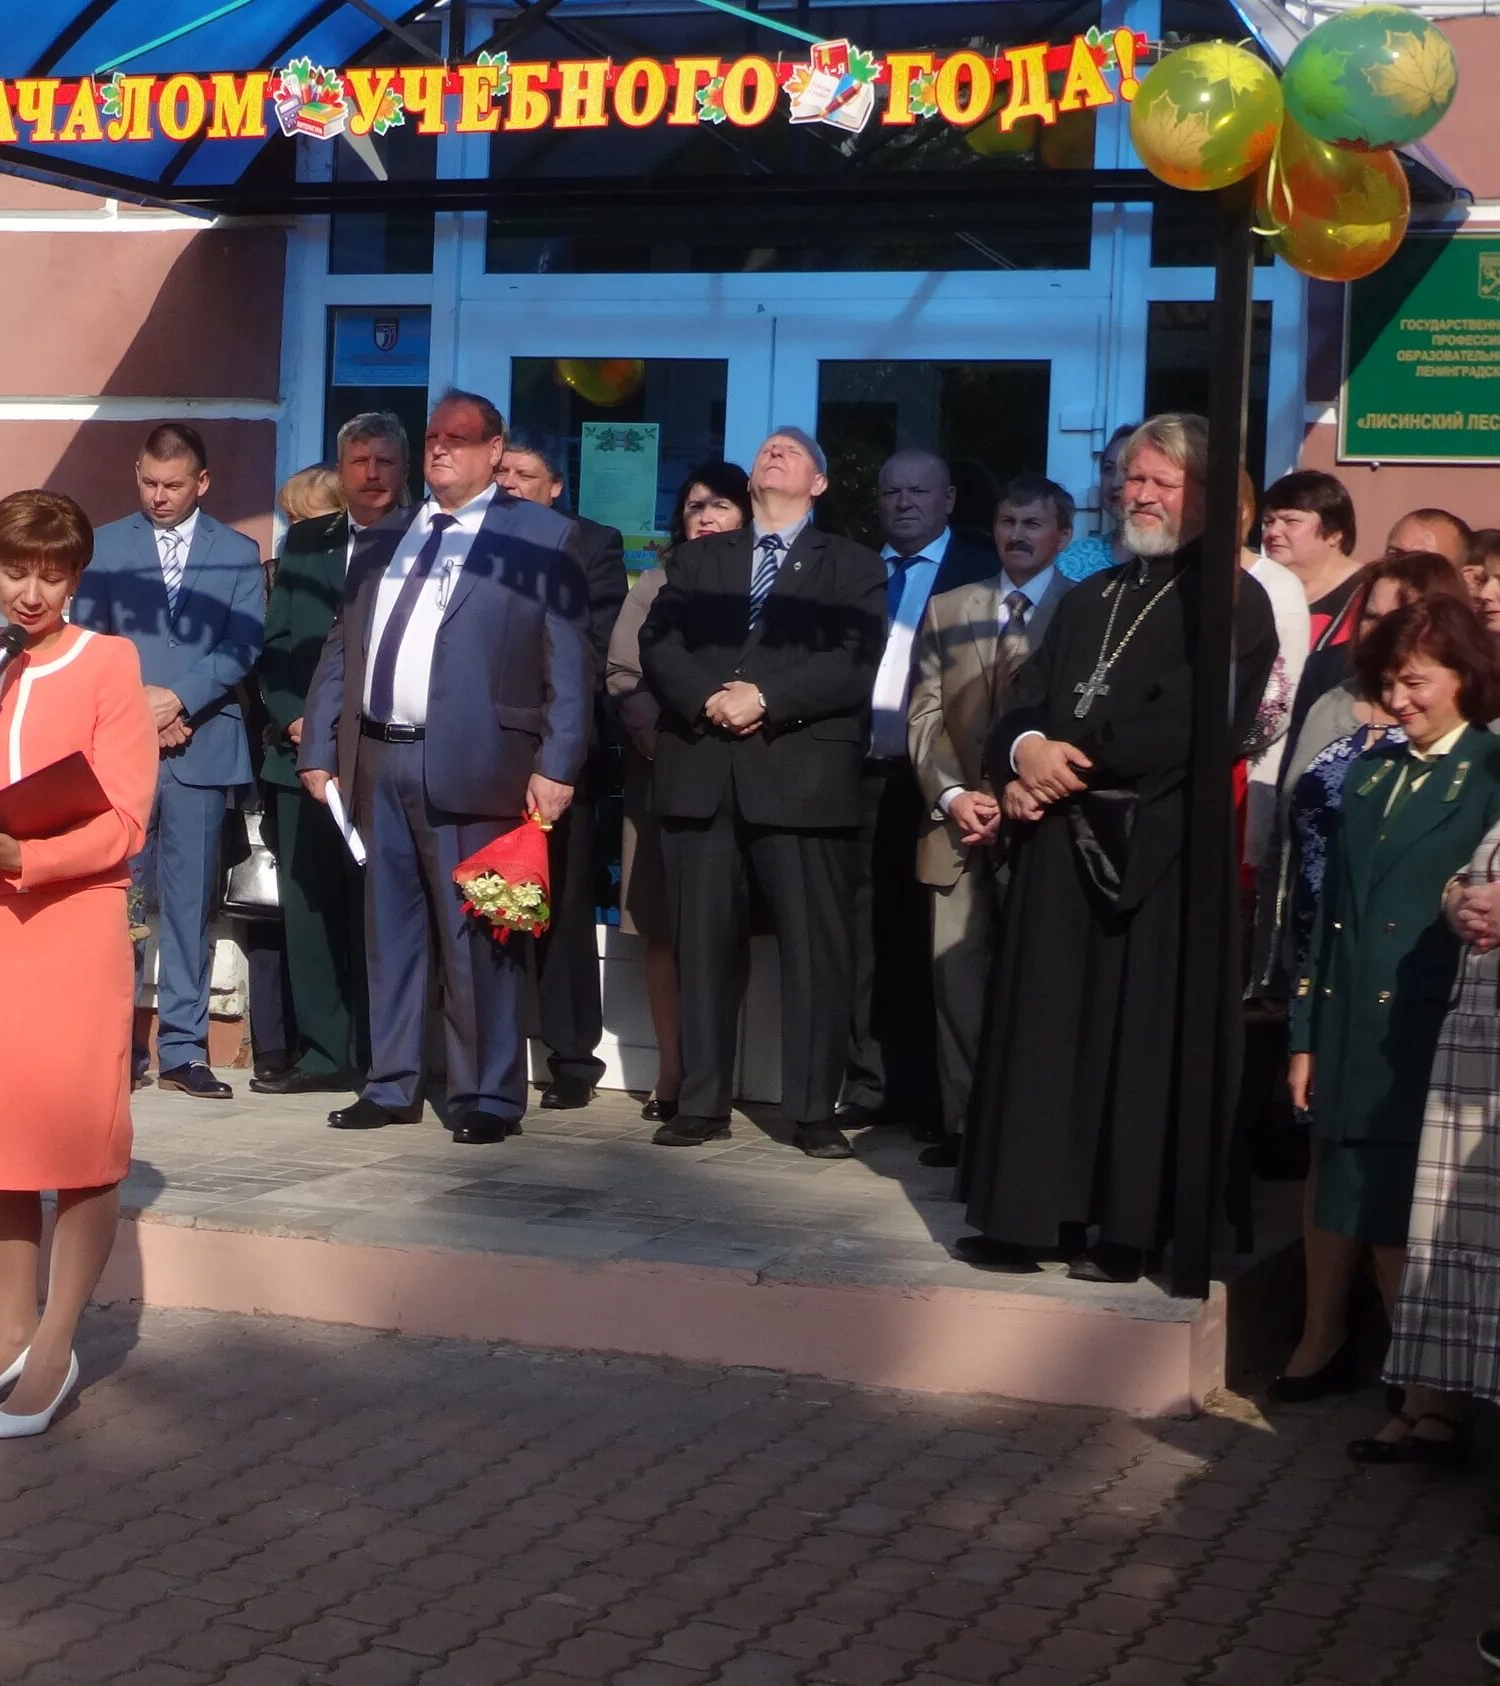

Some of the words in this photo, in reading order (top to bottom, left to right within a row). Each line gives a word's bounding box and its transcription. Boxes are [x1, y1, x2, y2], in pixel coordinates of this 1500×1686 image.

[346, 55, 777, 137] УЧЕБНОГО
[881, 26, 1141, 133] ГОДА!
[1357, 411, 1464, 430] «ЛИСИНСКИЙ
[1467, 413, 1500, 430] ЛЕС
